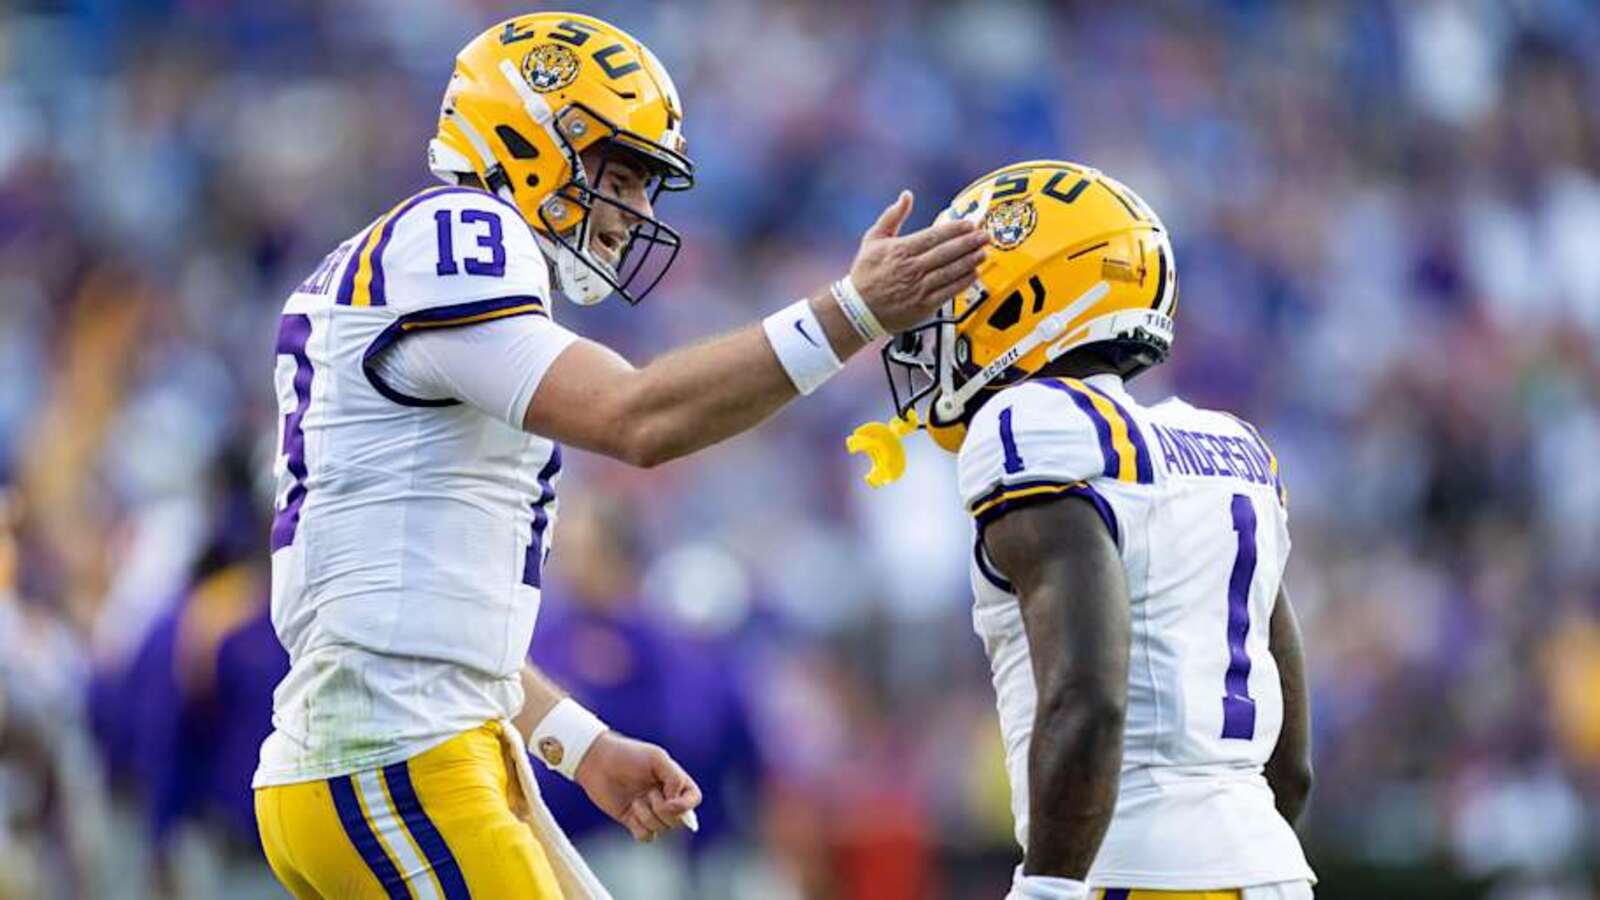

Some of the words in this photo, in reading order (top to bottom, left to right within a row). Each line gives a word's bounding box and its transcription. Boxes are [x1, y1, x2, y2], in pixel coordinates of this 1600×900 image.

[500, 20, 641, 80] LSU
[434, 209, 506, 278] 13
[999, 406, 1025, 474] 1
[1221, 493, 1256, 741] 1
